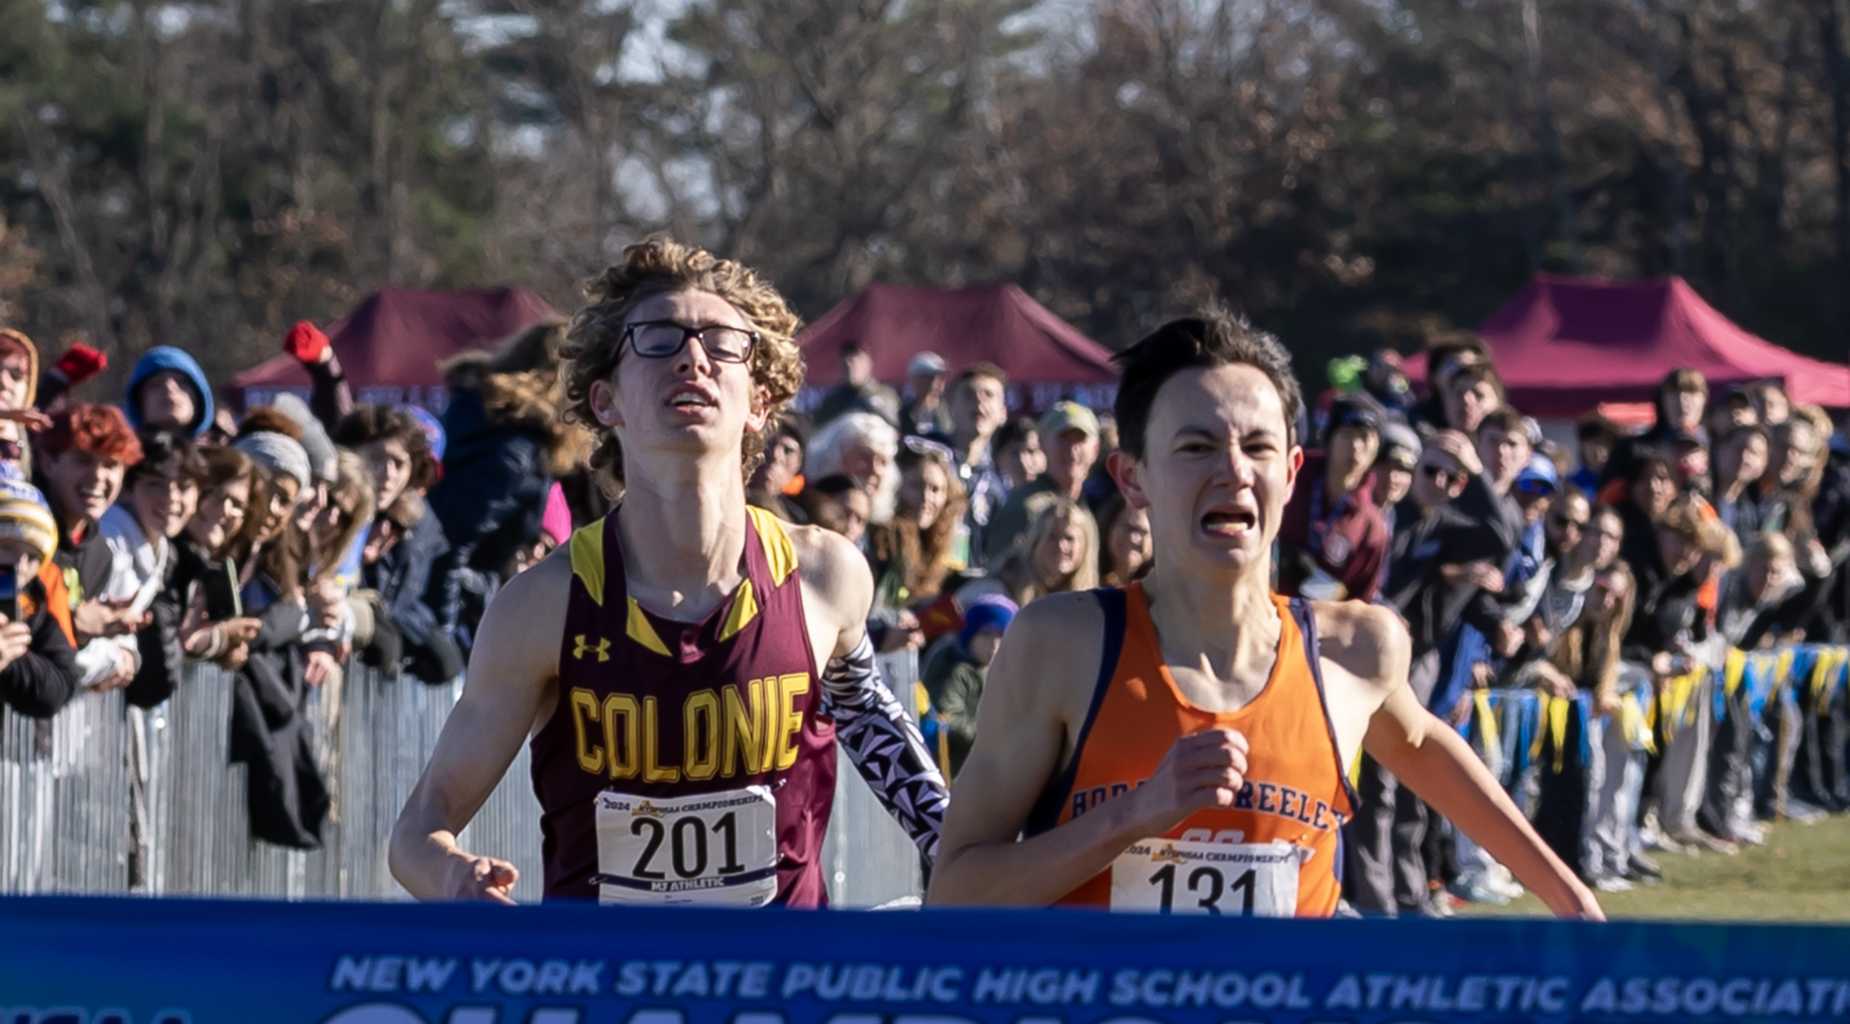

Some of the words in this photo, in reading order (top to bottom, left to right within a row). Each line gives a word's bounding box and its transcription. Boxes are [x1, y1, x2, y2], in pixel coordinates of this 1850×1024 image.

[571, 672, 810, 784] COLONIE
[603, 797, 631, 812] 2024
[1233, 781, 1345, 829] REELE
[630, 811, 745, 880] 201
[1124, 845, 1152, 856] 024
[670, 877, 725, 891] ATHLETIC
[1149, 864, 1256, 916] 131
[332, 957, 455, 993] NEW
[471, 959, 603, 993] YORK
[617, 960, 770, 999] STATE
[782, 964, 963, 1002] PUBLIC
[974, 967, 1099, 1004] HIGH
[1108, 969, 1311, 1009] SCHOOL
[1325, 974, 1568, 1013] ATHLETIC
